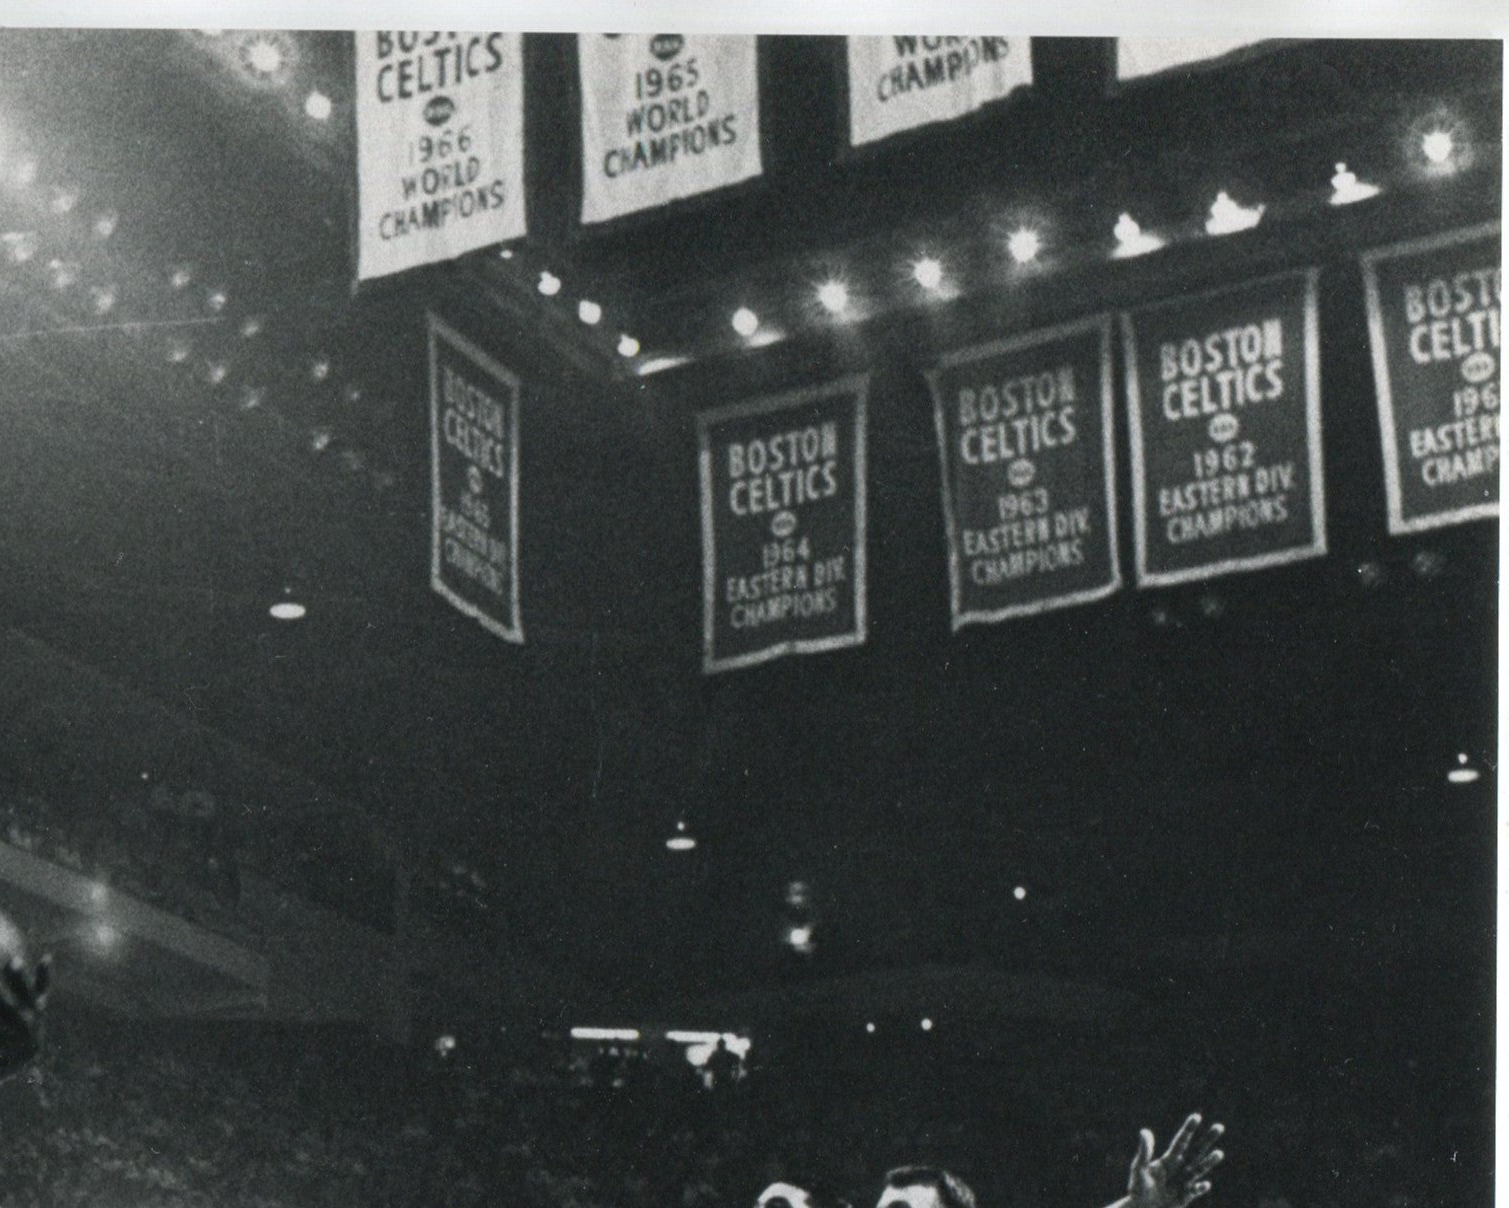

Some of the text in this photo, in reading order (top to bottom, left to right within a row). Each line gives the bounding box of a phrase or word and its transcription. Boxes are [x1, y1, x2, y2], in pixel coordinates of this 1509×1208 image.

[377, 31, 503, 103] CELTICS
[634, 57, 699, 101] 1965
[877, 36, 1009, 102] CHAMPIONS
[626, 88, 710, 138] WORLD
[603, 113, 737, 178] CHAMPIONS
[401, 156, 480, 201] WORLD
[379, 179, 503, 241] CHAMPIONS
[1160, 318, 1281, 381] BOSTON
[1409, 306, 1499, 364] CELTI
[958, 368, 1074, 426] BOSTON
[1162, 359, 1282, 420] CELTICS
[1453, 382, 1497, 417] 196
[443, 408, 503, 479] CELTICS
[728, 421, 835, 477] BOSTON
[961, 406, 1076, 464] CELTICS
[1193, 441, 1255, 478] 1962
[729, 460, 835, 515] CELTICS
[1421, 445, 1499, 486] CHAMP
[1158, 473, 1249, 517] EASTERN
[1166, 494, 1287, 543] CHAMPIONS
[962, 517, 1047, 555] EASTERN
[971, 538, 1082, 585] CHAMPIONS
[725, 565, 808, 603] EASTERN
[730, 586, 835, 628] CHAMPIONS
